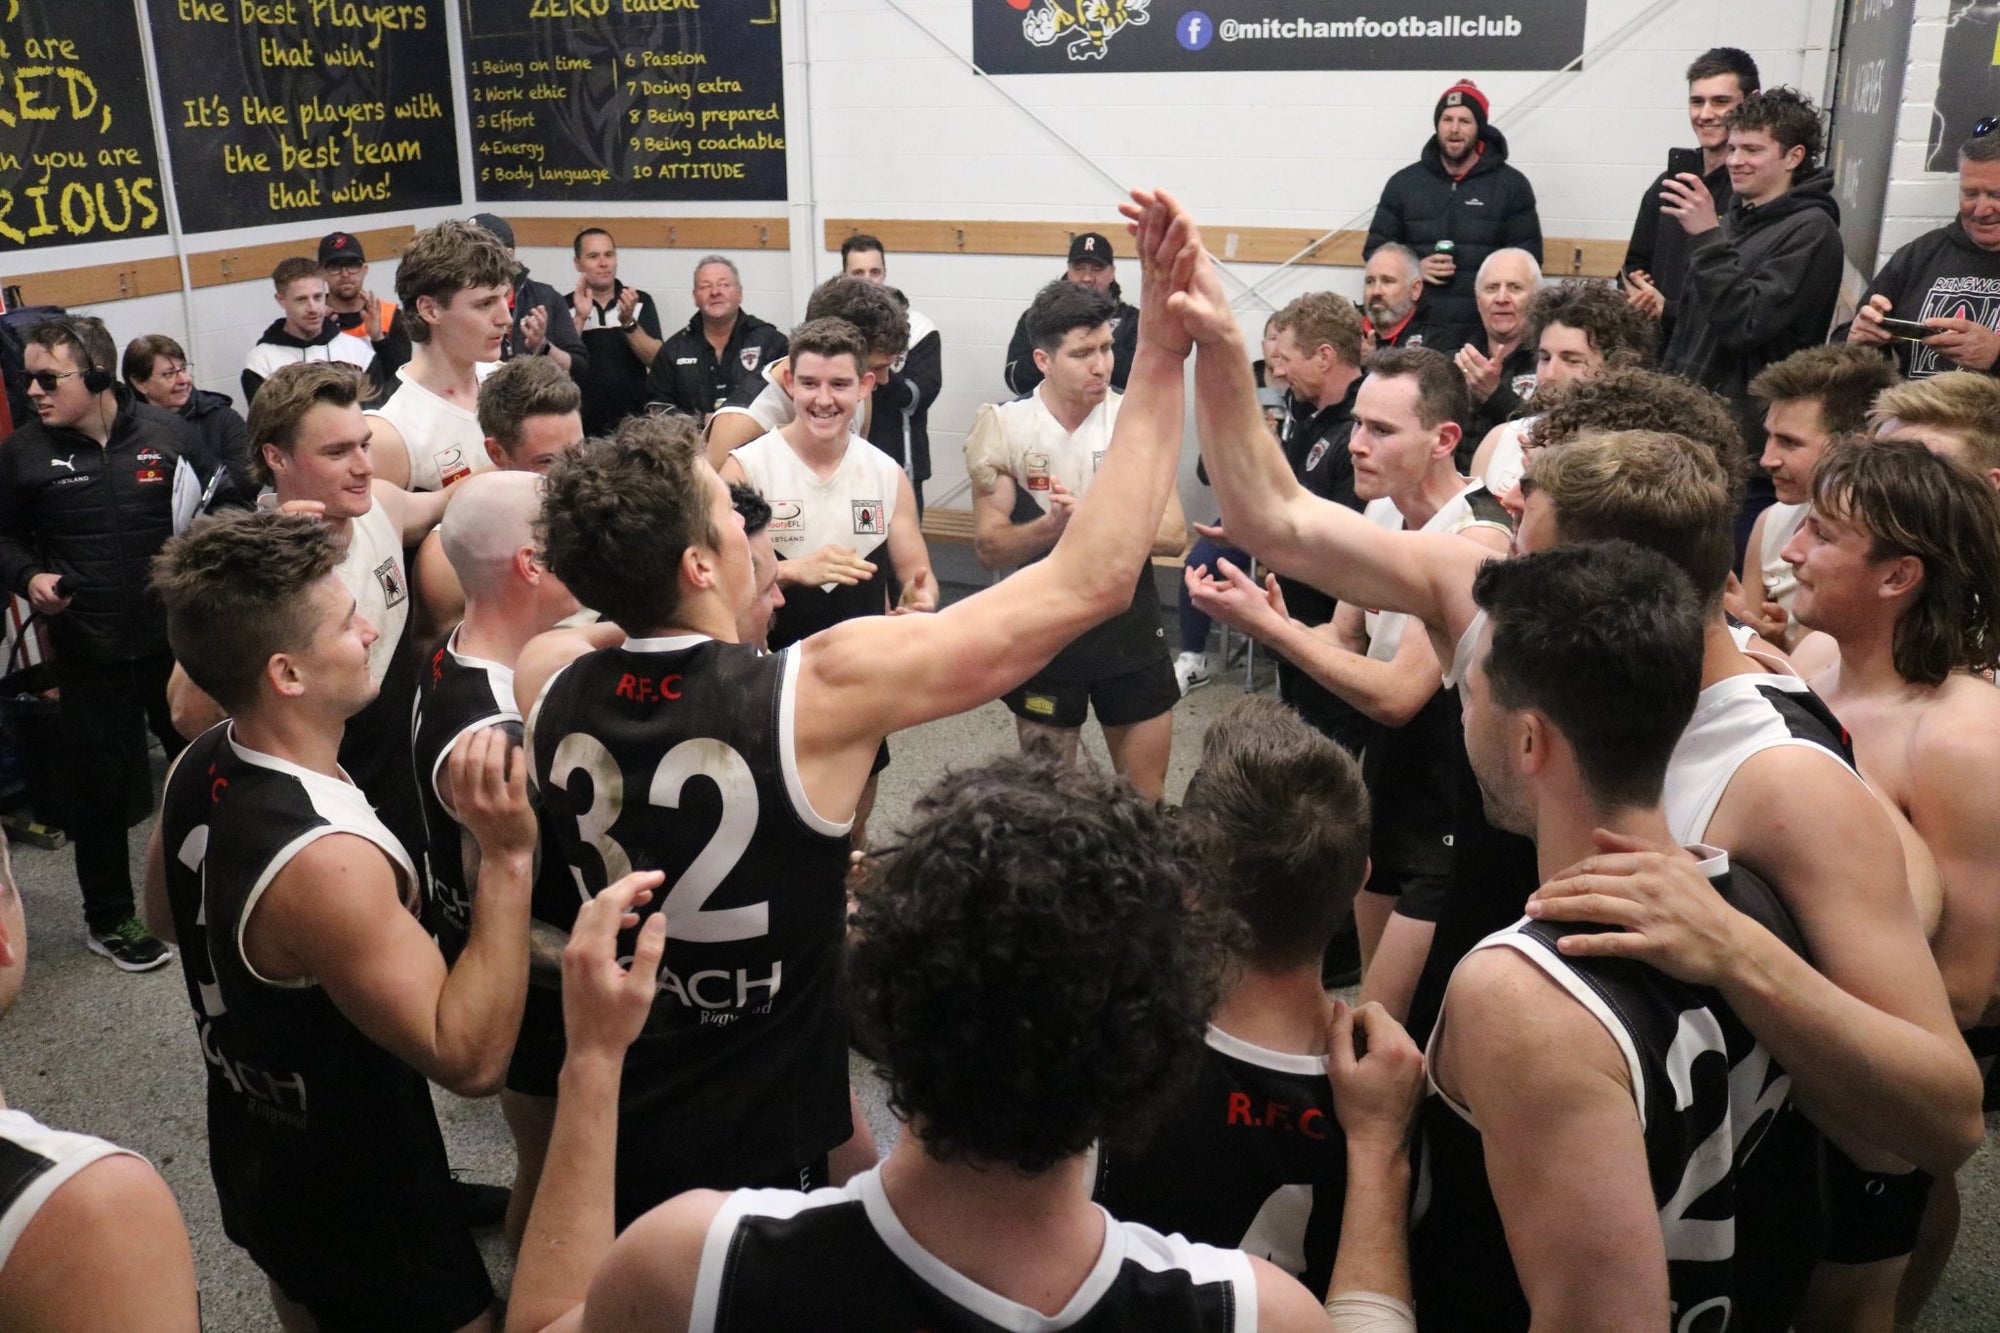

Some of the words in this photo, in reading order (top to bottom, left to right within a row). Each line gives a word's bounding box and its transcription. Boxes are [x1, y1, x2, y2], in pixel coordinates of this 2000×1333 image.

[179, 0, 227, 22] the
[241, 0, 296, 24] best
[1219, 15, 1522, 42] @mitchamfootballclub
[25, 38, 80, 60] are
[260, 38, 314, 67] that
[324, 43, 375, 68] win.
[625, 56, 635, 67] 6
[642, 51, 706, 66] Passion
[472, 61, 480, 74] 1
[484, 61, 524, 79] Being
[528, 61, 550, 72] on
[555, 56, 592, 71] time
[473, 89, 481, 102] 2
[486, 88, 523, 101] Work
[529, 85, 567, 100] ethic
[627, 81, 637, 93] 7
[641, 81, 691, 100] Doing
[697, 78, 741, 93] extra
[184, 96, 229, 127] It's
[243, 97, 288, 124] the
[300, 97, 386, 138] players
[395, 95, 441, 118] with
[477, 116, 486, 128] 3
[490, 110, 536, 132] Effort
[629, 110, 640, 123] 8
[647, 109, 695, 128] Being
[702, 103, 779, 129] prepared
[224, 145, 270, 173] the
[281, 135, 341, 170] best
[353, 138, 420, 164] team
[479, 142, 491, 154] 4
[493, 141, 545, 161] Energy
[630, 137, 641, 150] 9
[644, 136, 692, 157] Being
[698, 132, 785, 150] coachable
[33, 152, 88, 185] you
[98, 148, 142, 166] are
[482, 167, 490, 181] 5
[495, 165, 534, 189] Body
[539, 165, 611, 187] language
[634, 165, 652, 179] 10
[659, 163, 744, 179] ATTITUDE
[269, 181, 321, 210] that
[332, 172, 391, 202] wins!
[1085, 237, 1095, 250] R
[549, 732, 770, 943] 32
